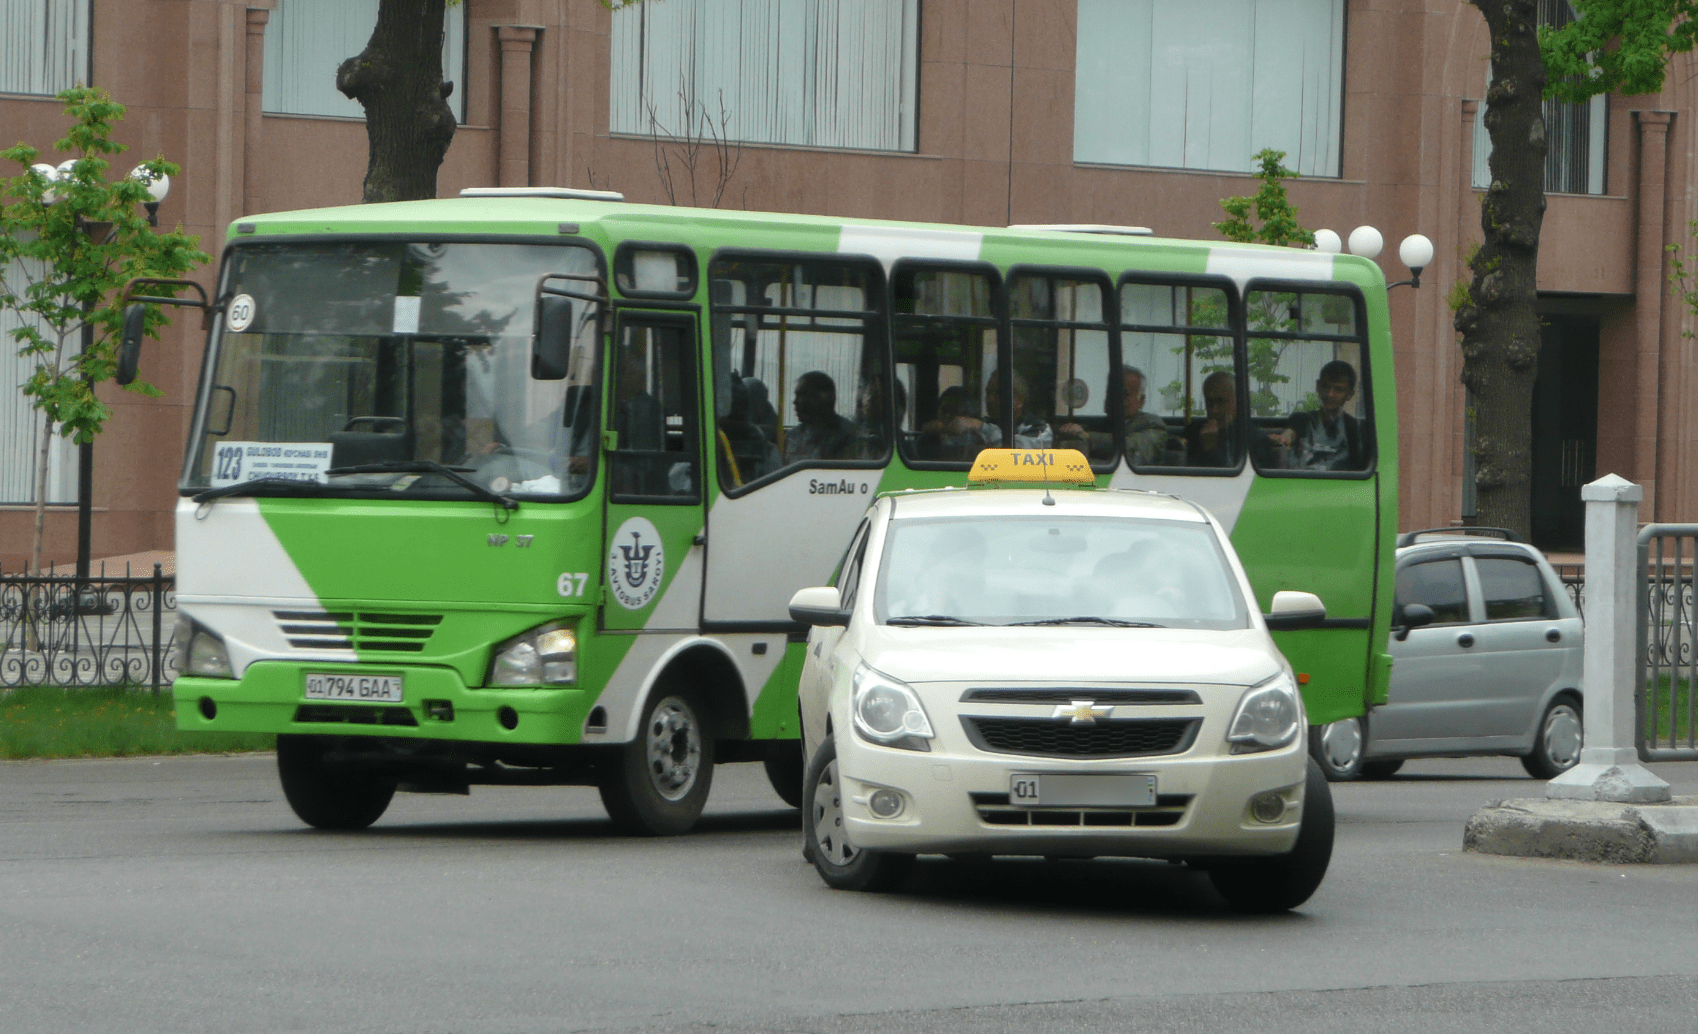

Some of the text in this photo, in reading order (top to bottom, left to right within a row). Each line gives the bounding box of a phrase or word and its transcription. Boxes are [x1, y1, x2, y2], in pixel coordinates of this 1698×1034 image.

[233, 304, 249, 321] 60
[217, 446, 243, 480] 123
[1010, 453, 1054, 466] TAXI
[515, 533, 533, 548] 37
[558, 572, 589, 597] 67
[309, 677, 391, 698] 01 794 GAA
[1017, 780, 1037, 798] 01
